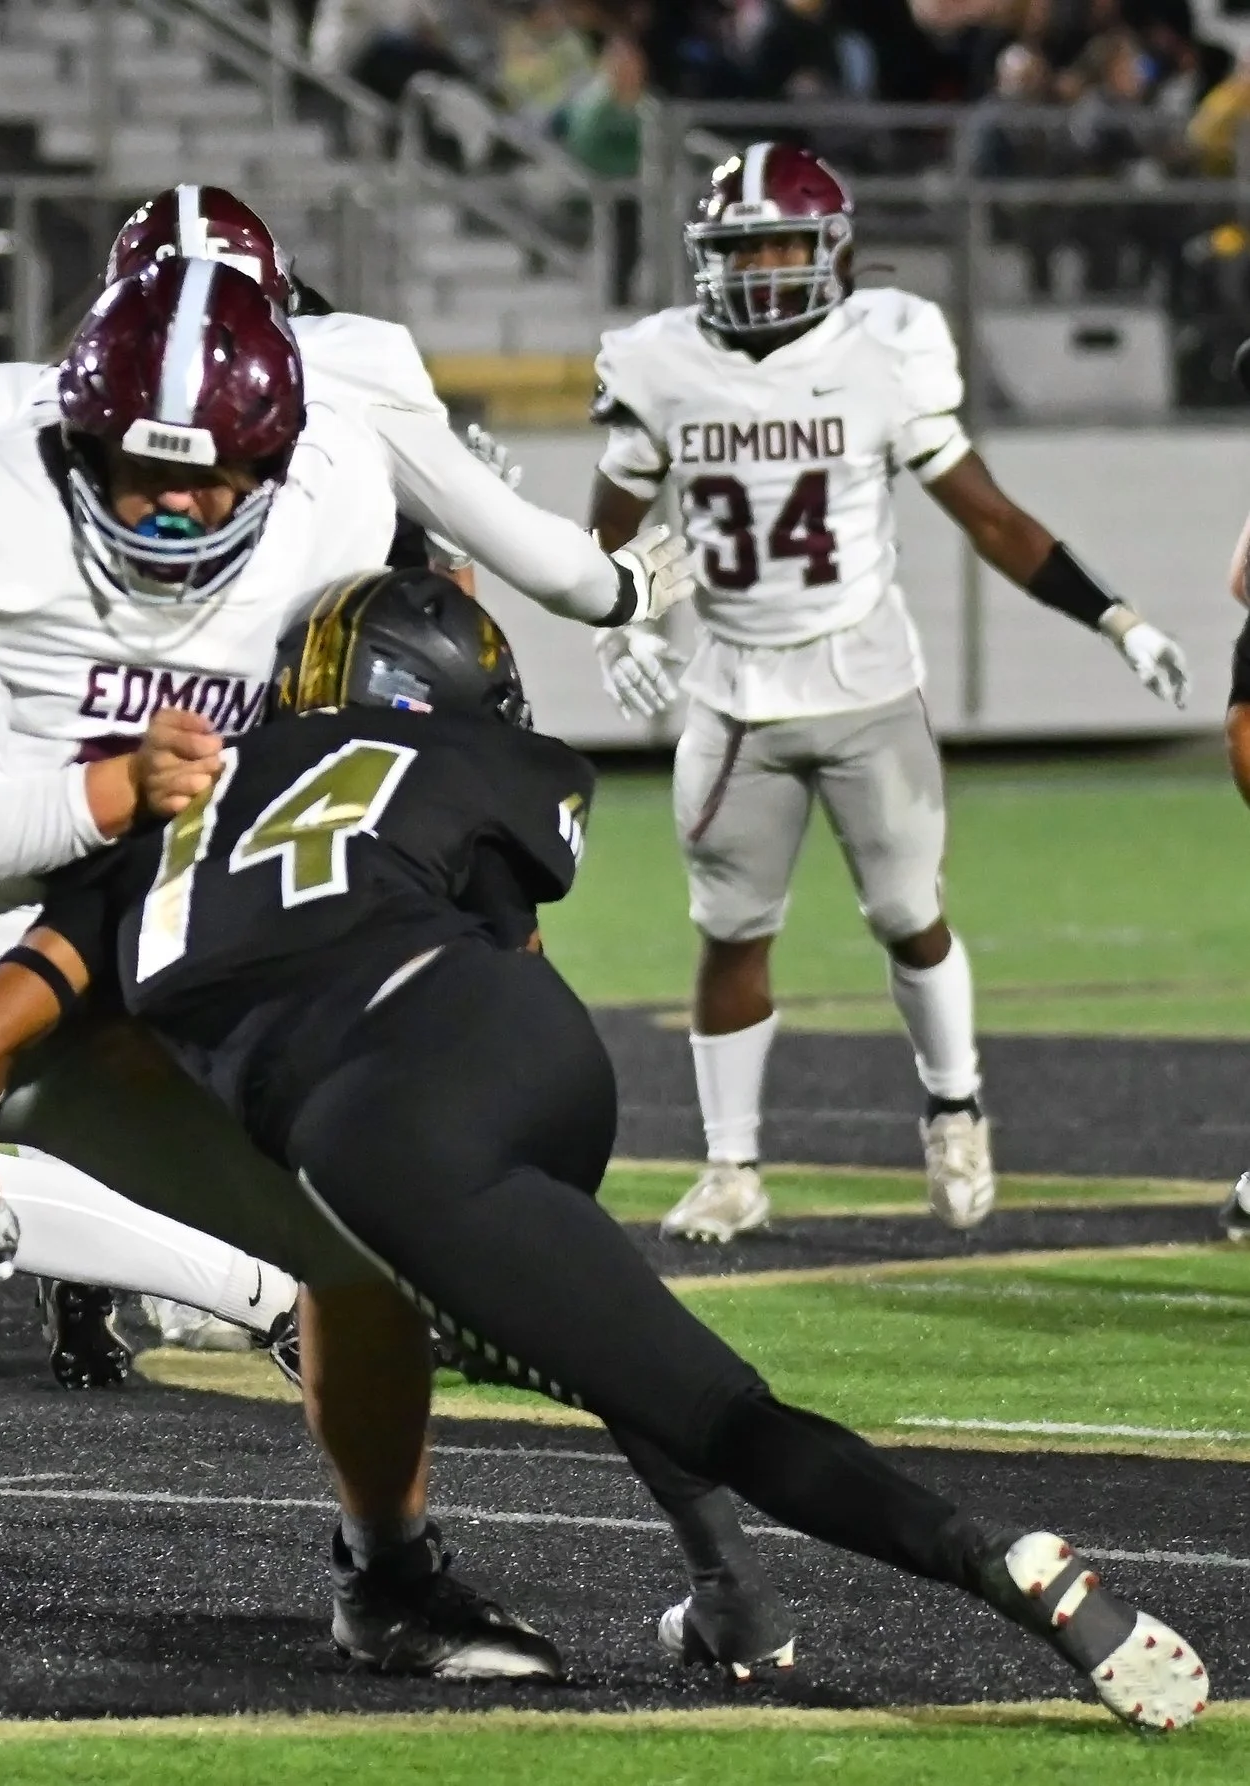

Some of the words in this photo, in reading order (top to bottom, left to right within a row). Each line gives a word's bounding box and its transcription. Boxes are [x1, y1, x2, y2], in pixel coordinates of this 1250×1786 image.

[680, 416, 846, 463] EDMOND
[686, 468, 842, 590] 34
[79, 664, 270, 732] EDMON
[137, 738, 419, 983] 14
